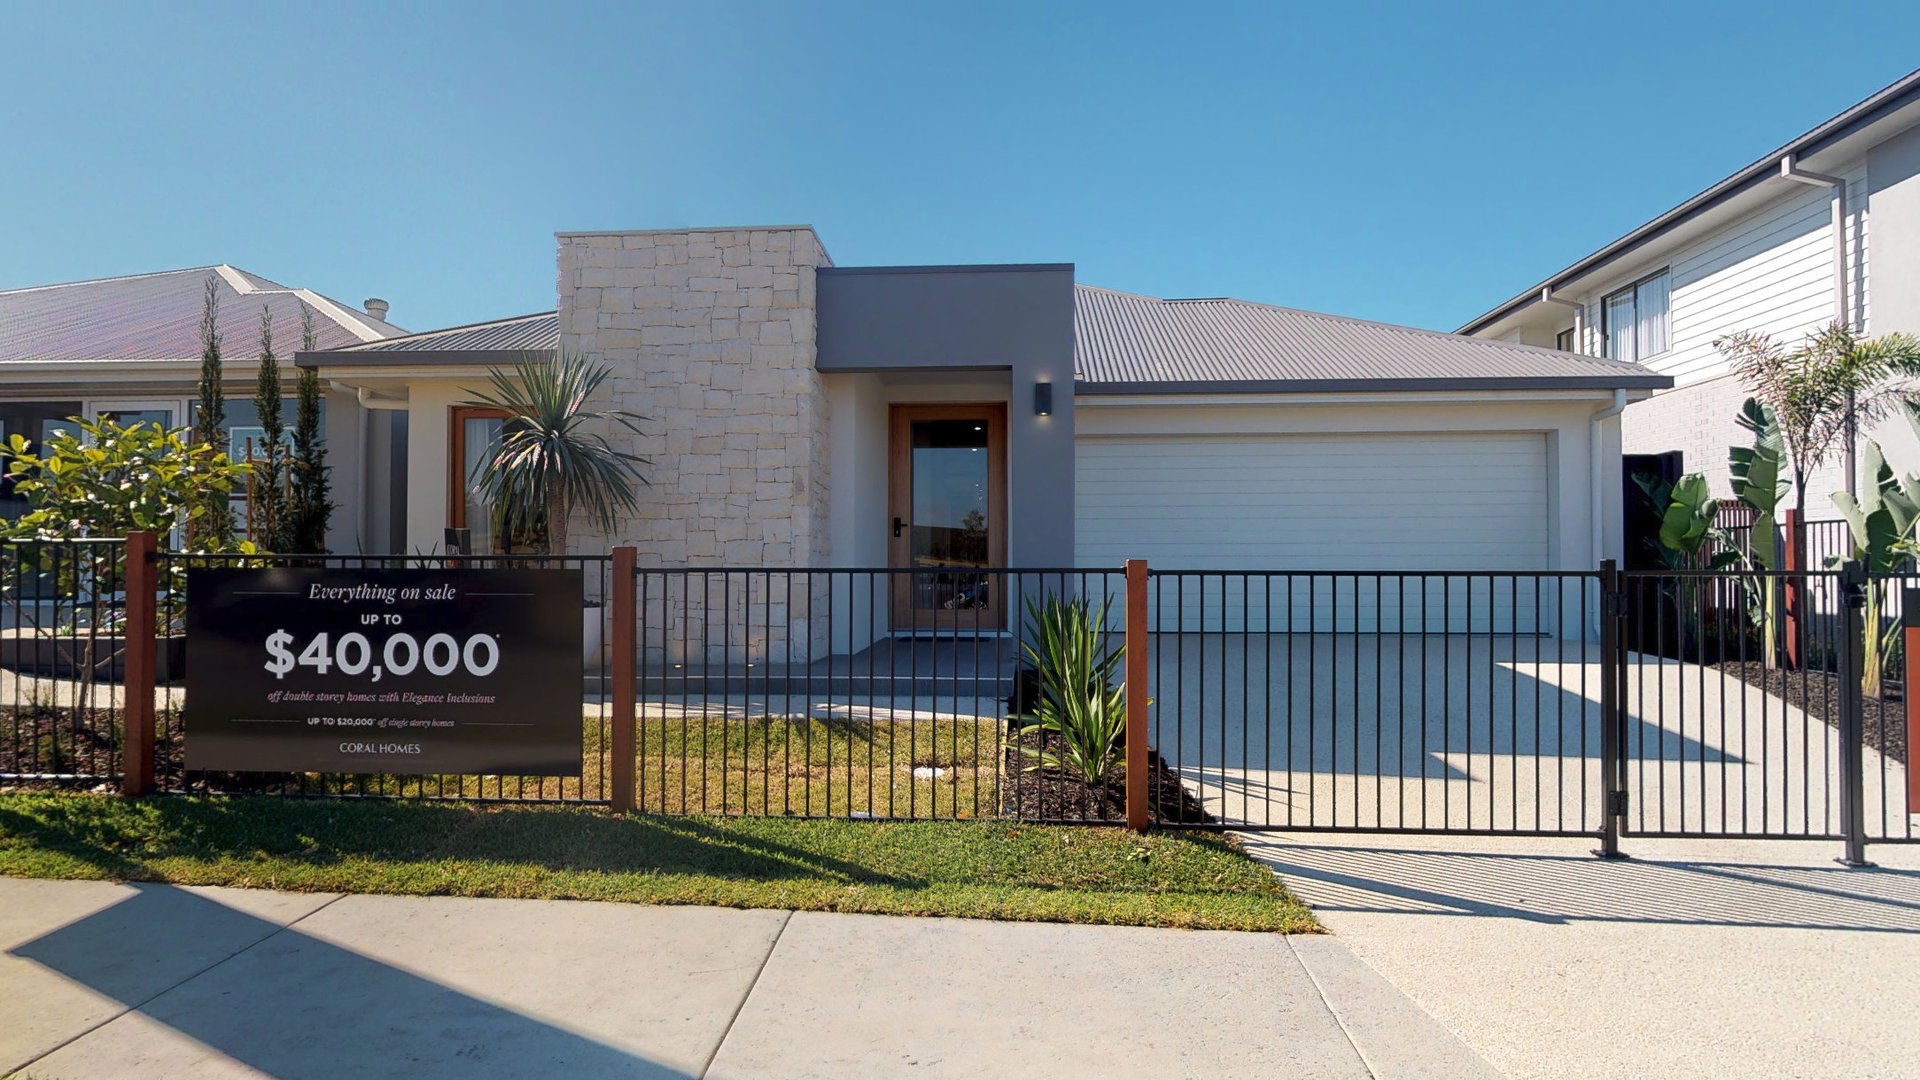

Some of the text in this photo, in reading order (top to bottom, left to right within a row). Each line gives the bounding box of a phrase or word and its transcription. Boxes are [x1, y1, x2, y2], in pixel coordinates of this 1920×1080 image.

[309, 582, 456, 605] Everything on sale
[361, 614, 402, 625] UP TO
[267, 690, 496, 706] off double storey homes with Elegance Inclusions
[307, 717, 320, 726] UP
[322, 717, 334, 726] TO
[431, 718, 455, 728] homes
[339, 742, 421, 755] CORAL HOMES
